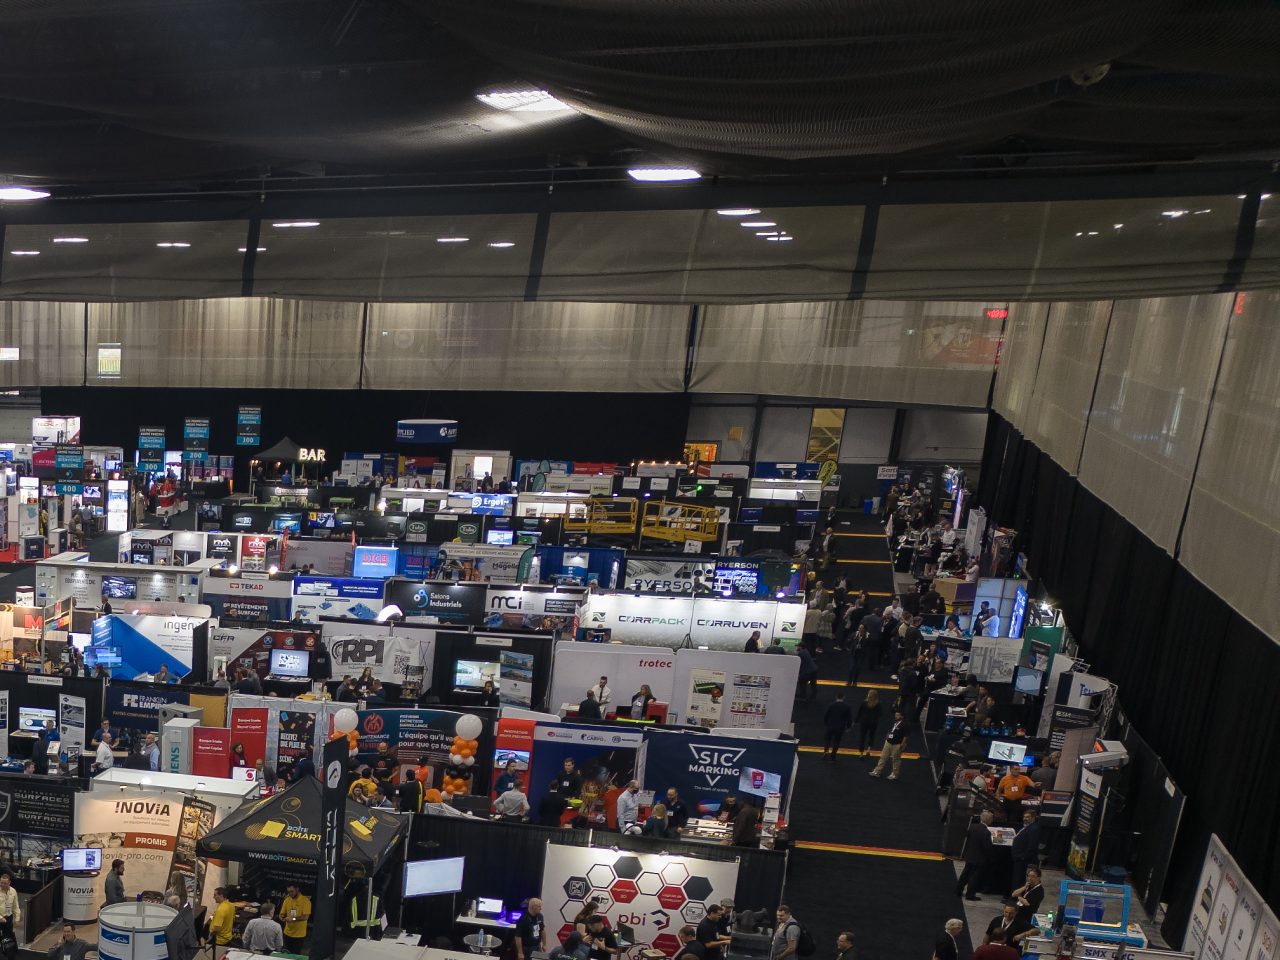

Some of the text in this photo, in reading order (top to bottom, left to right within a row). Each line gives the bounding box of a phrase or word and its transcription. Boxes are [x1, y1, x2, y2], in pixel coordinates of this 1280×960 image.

[299, 448, 326, 462] BAR
[241, 583, 264, 591] TEKAD
[634, 578, 693, 590] RYERSO
[430, 592, 450, 600] Salons
[429, 600, 462, 608] Industriels
[618, 615, 685, 625] CORRPACK
[697, 619, 768, 629] CORRUVEN
[341, 639, 385, 664] RPI
[638, 657, 673, 669] trotec
[139, 695, 168, 704] FRANKLIN
[139, 701, 167, 710] EMPI
[398, 731, 445, 741] L'équipe qu'il
[699, 750, 734, 766] SIC
[688, 764, 741, 776] MARKING
[14, 792, 70, 804] SURFACES
[18, 813, 70, 824] SURFACES
[287, 825, 309, 833] BOÎTE
[135, 836, 168, 847] PROMIS
[285, 831, 321, 842] SMART
[101, 852, 164, 862] novia-pro.com
[618, 912, 647, 926] pbi
[1084, 949, 1107, 958] SMX
